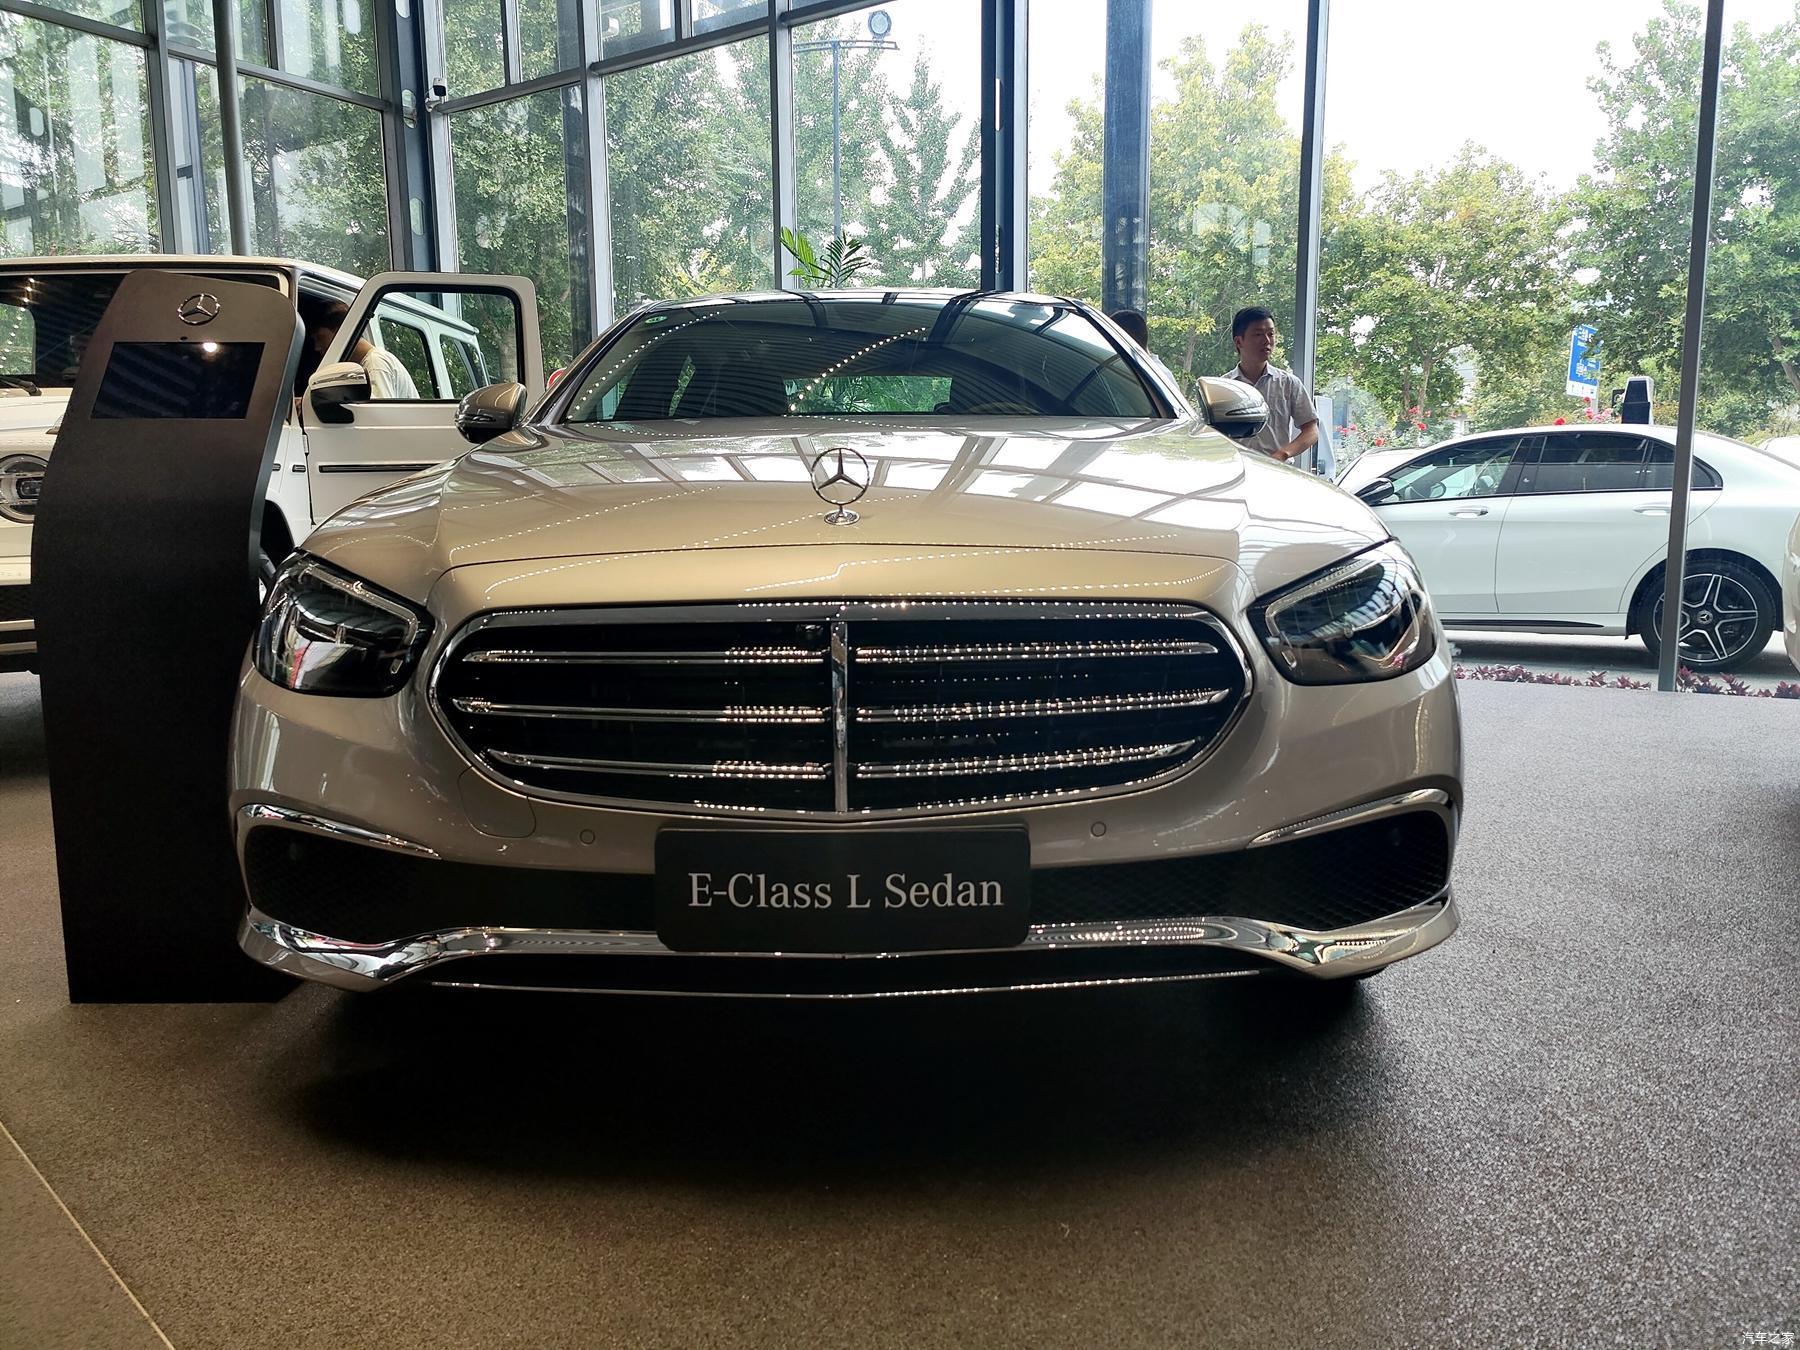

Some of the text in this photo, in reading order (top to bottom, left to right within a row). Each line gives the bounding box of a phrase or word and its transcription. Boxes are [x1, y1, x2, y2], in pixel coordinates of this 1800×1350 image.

[688, 872, 1004, 909] E-Class L Sedan
